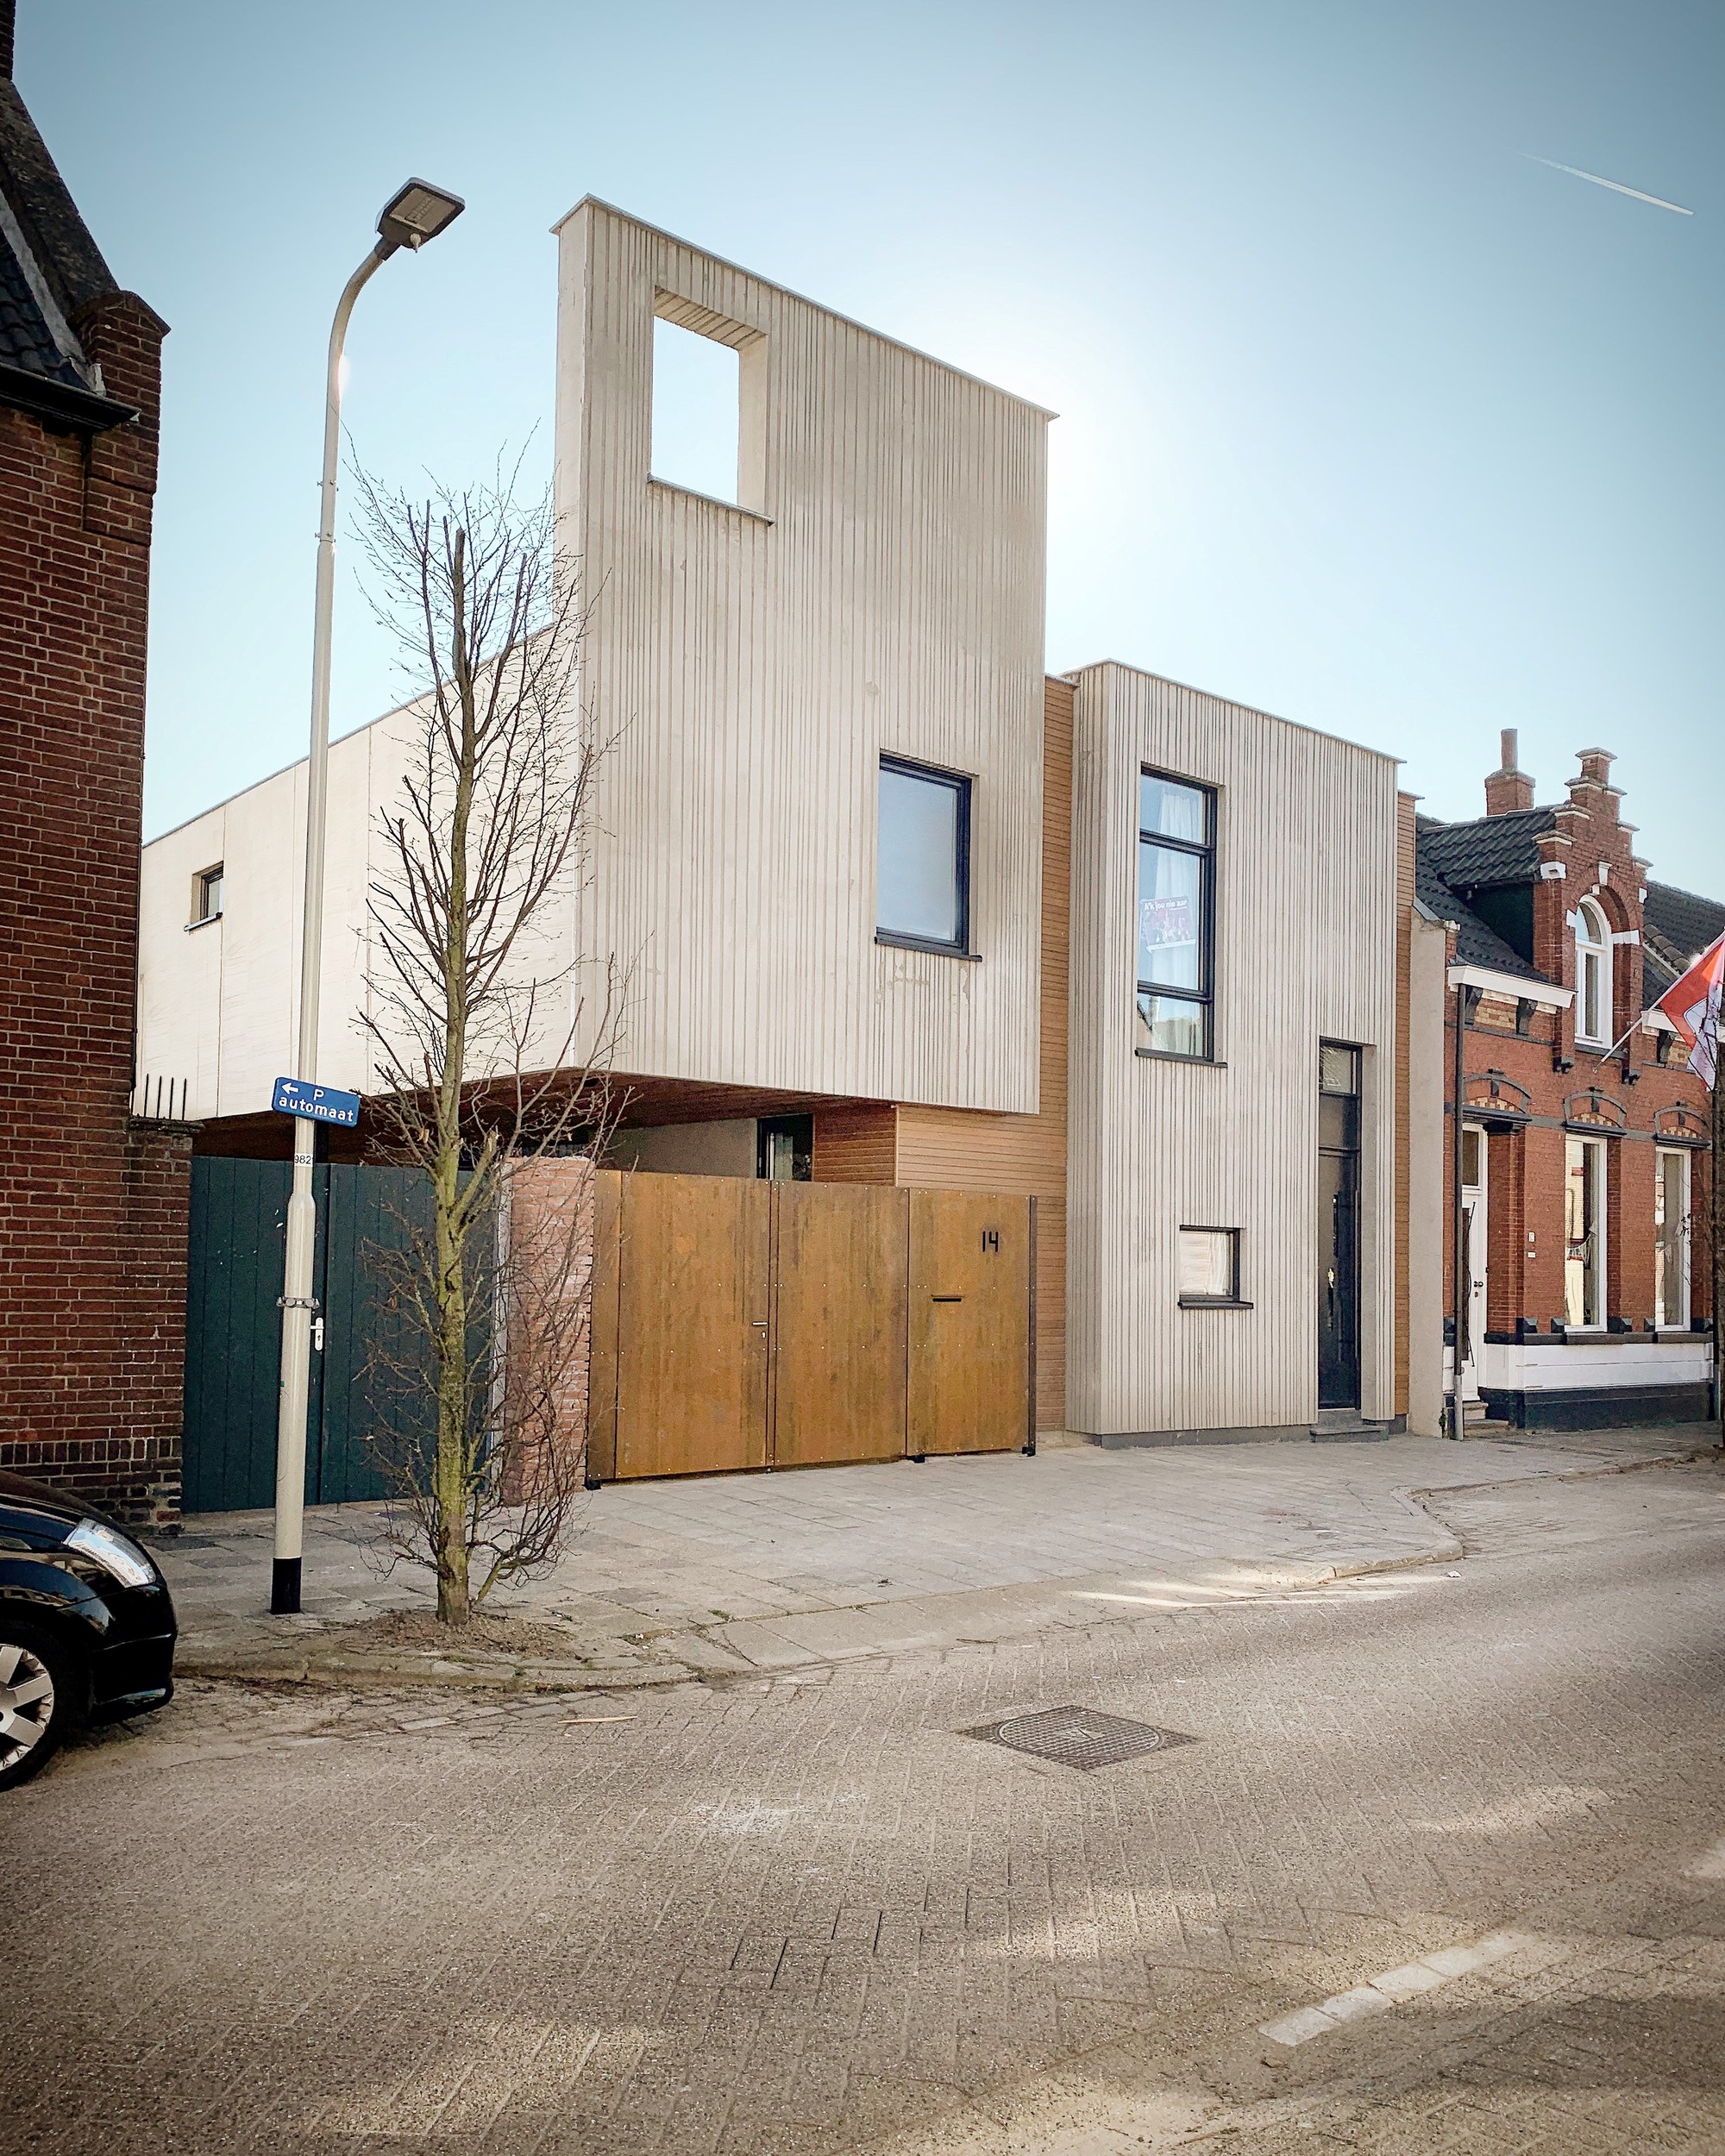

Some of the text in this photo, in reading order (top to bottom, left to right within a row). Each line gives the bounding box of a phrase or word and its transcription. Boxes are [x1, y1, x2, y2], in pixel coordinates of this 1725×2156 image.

[1155, 901, 1165, 912] jou
[1165, 899, 1176, 908] nie
[313, 1088, 324, 1101] P
[279, 1097, 354, 1122] automaat
[294, 1155, 311, 1164] 982
[982, 1231, 999, 1253] 14
